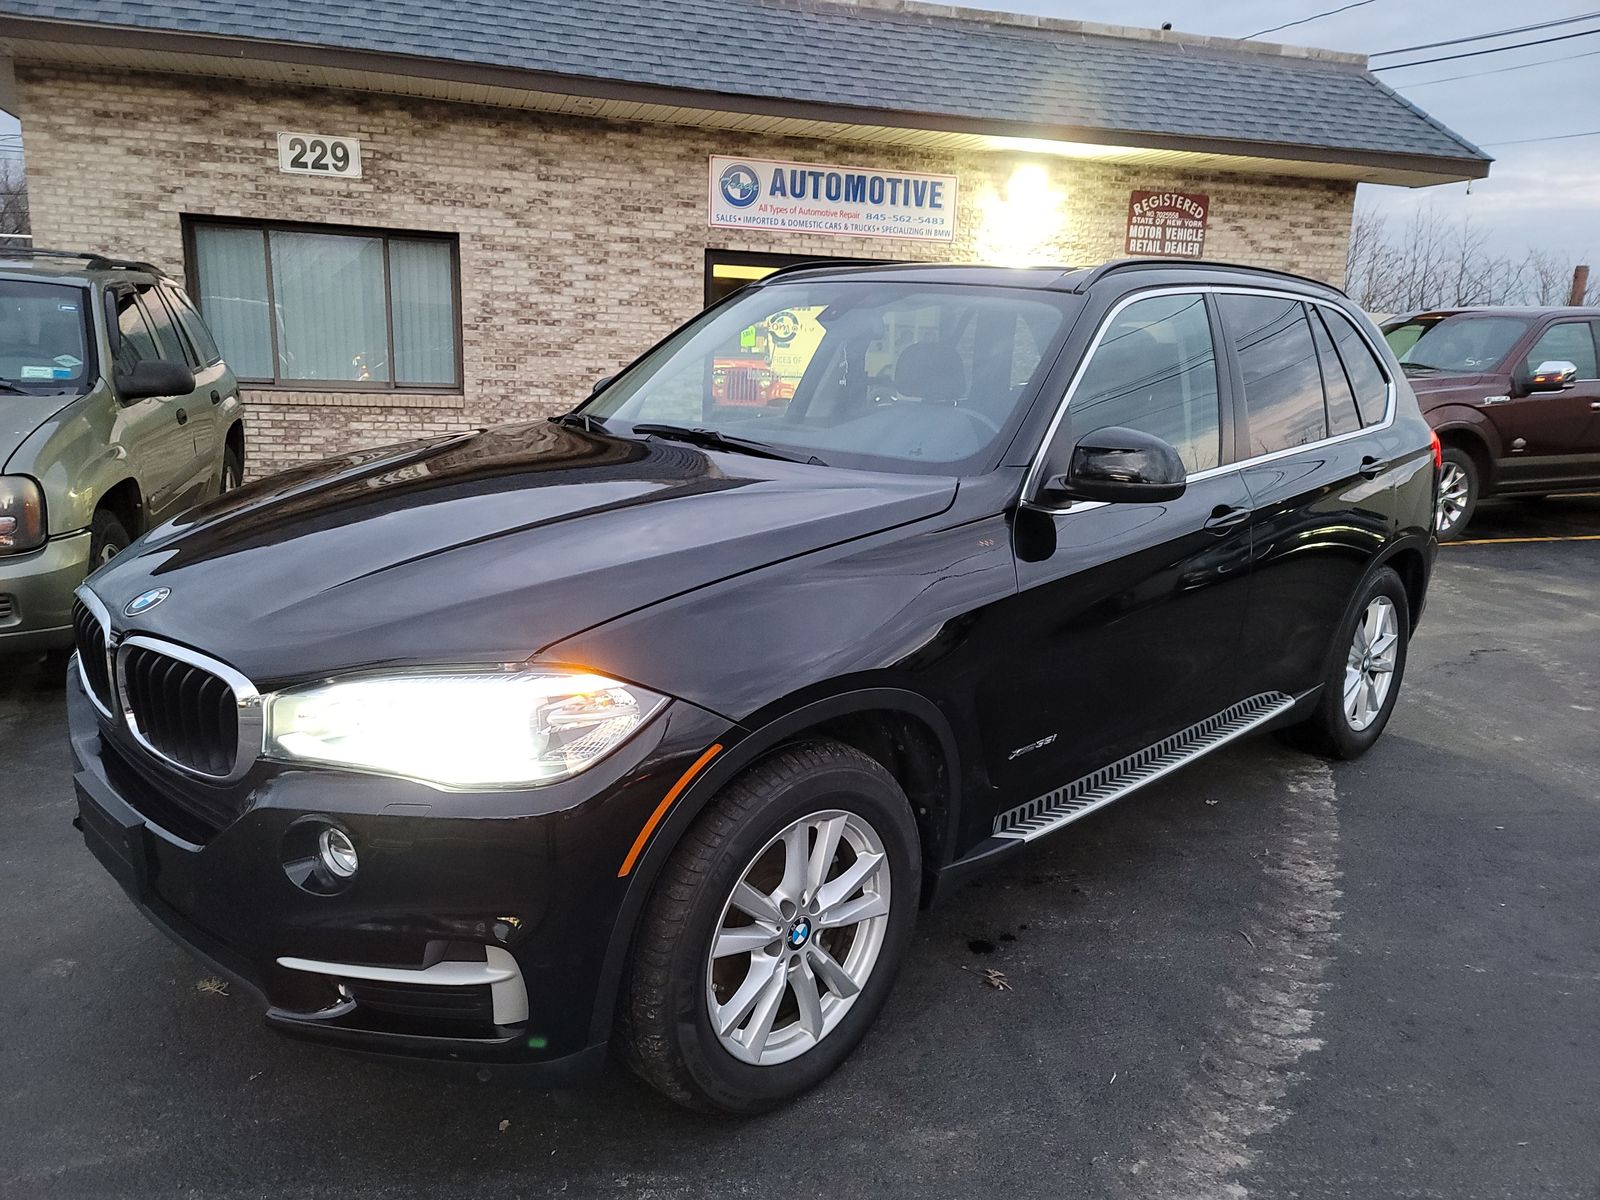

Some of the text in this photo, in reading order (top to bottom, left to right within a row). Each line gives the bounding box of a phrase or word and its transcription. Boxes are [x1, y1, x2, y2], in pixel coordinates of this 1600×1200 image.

[289, 138, 350, 172] 229
[769, 168, 943, 208] AUTOMOTIVE
[758, 204, 860, 219] All Types of Automotive Repair
[1133, 193, 1204, 219] REGISTERED
[716, 213, 737, 222] SALES
[743, 217, 778, 226] IMPORTED
[781, 218, 786, 226] &
[788, 218, 824, 228] DOMESTIC
[825, 221, 842, 230] CARS
[844, 222, 848, 230] &
[851, 223, 876, 232] TRUCKS
[881, 226, 924, 236] SPECIALIZING
[865, 212, 945, 225] 845-562-5483
[1132, 216, 1153, 224] STATE
[1155, 217, 1165, 225] OF
[1166, 218, 1182, 226] NEW
[1129, 225, 1203, 241] MOTOR VEHICLE
[1129, 239, 1200, 255] RETAIL DEALER
